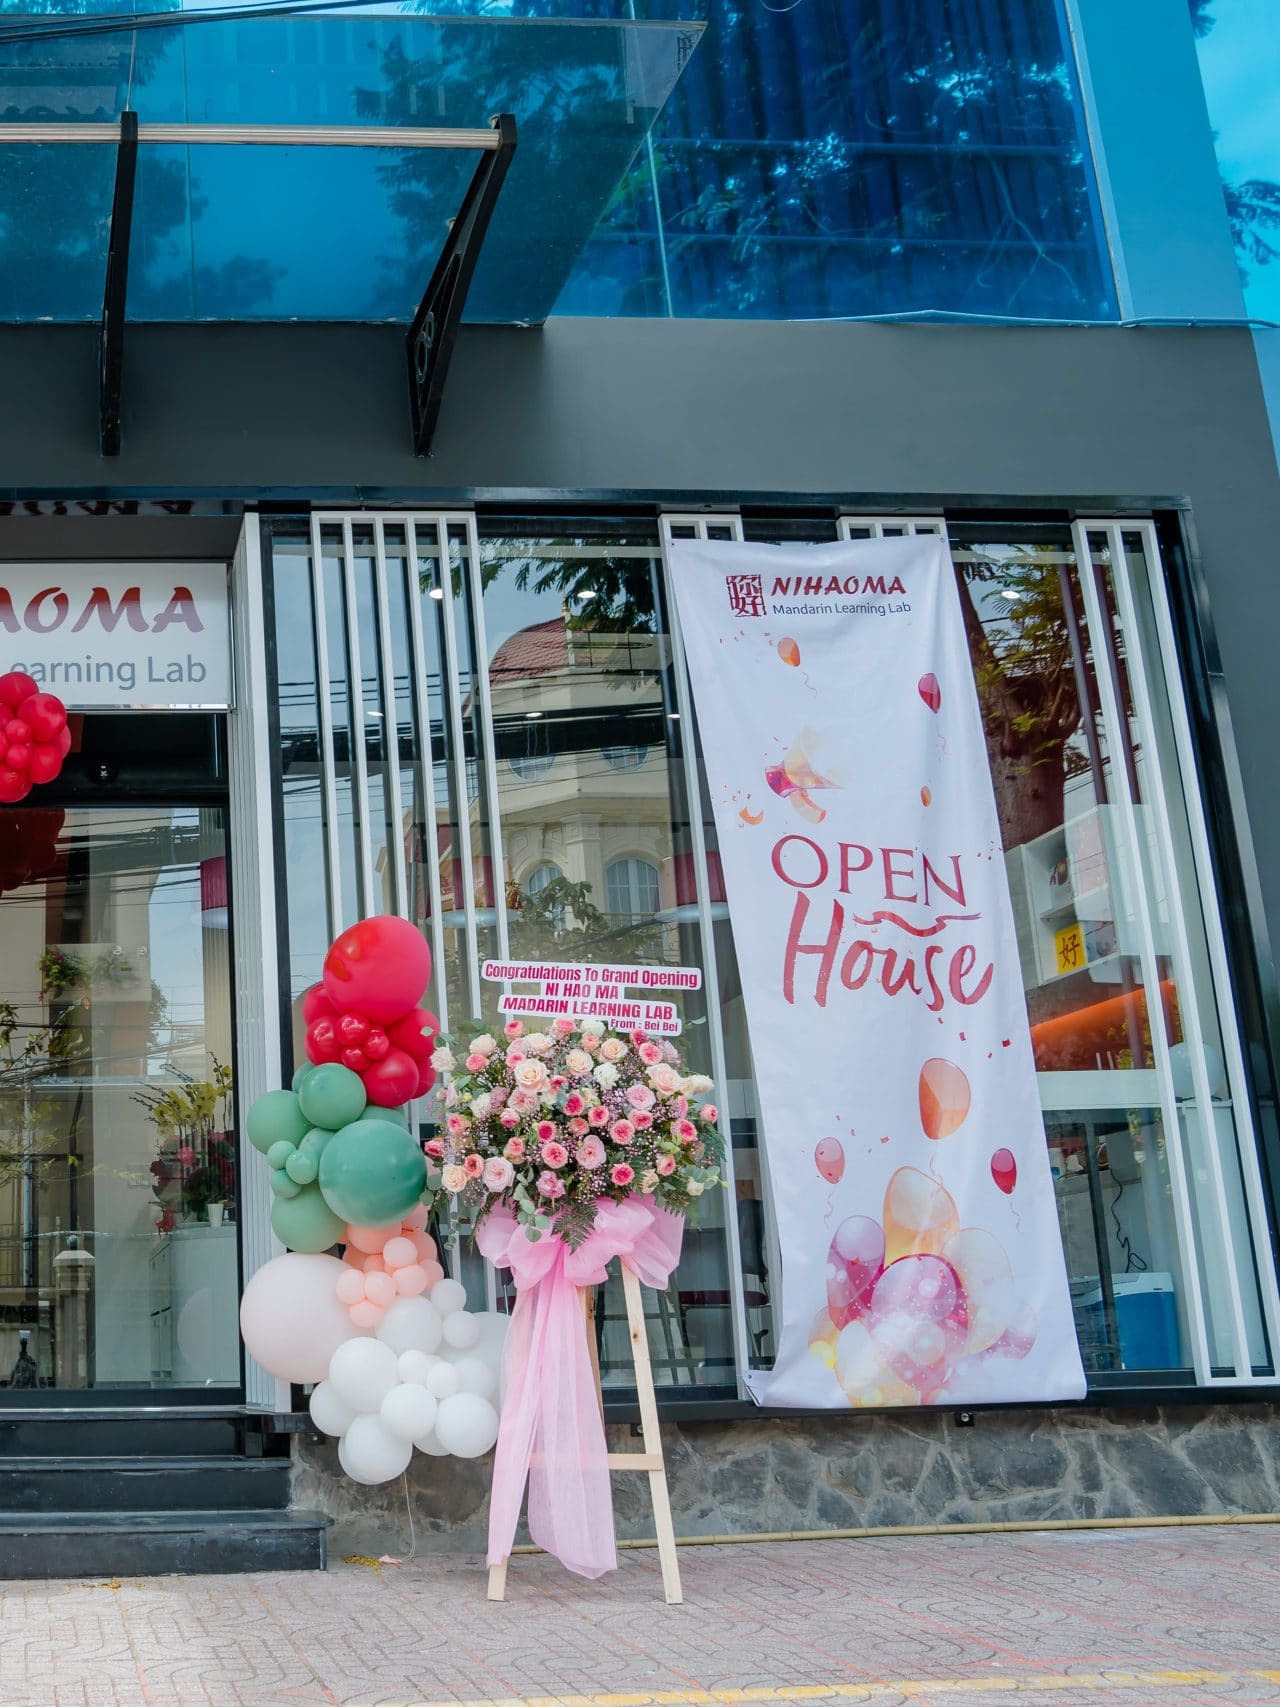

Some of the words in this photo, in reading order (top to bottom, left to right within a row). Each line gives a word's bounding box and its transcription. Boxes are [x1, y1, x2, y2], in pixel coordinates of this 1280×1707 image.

[726, 574, 767, 617] 你好
[771, 576, 907, 596] NIHAOMA
[772, 603, 832, 615] Mandarin
[835, 602, 886, 617] Learning
[888, 602, 912, 613] Lab
[148, 654, 207, 683] Lab
[771, 834, 967, 907] OPEN
[783, 891, 993, 1011] House
[1058, 932, 1082, 969] 好
[485, 963, 581, 981] Congratulations
[585, 967, 598, 982] To
[601, 969, 638, 984] Grand
[642, 970, 698, 988] Opening
[545, 983, 559, 996] NI
[563, 984, 591, 998] HAO
[595, 985, 619, 999] MA
[503, 997, 569, 1014] MADARIN
[573, 1001, 640, 1018] LEARNING
[645, 1004, 673, 1020] LAB
[610, 1018, 636, 1029] From
[644, 1020, 661, 1031] Bei
[663, 1022, 678, 1032] Bei
